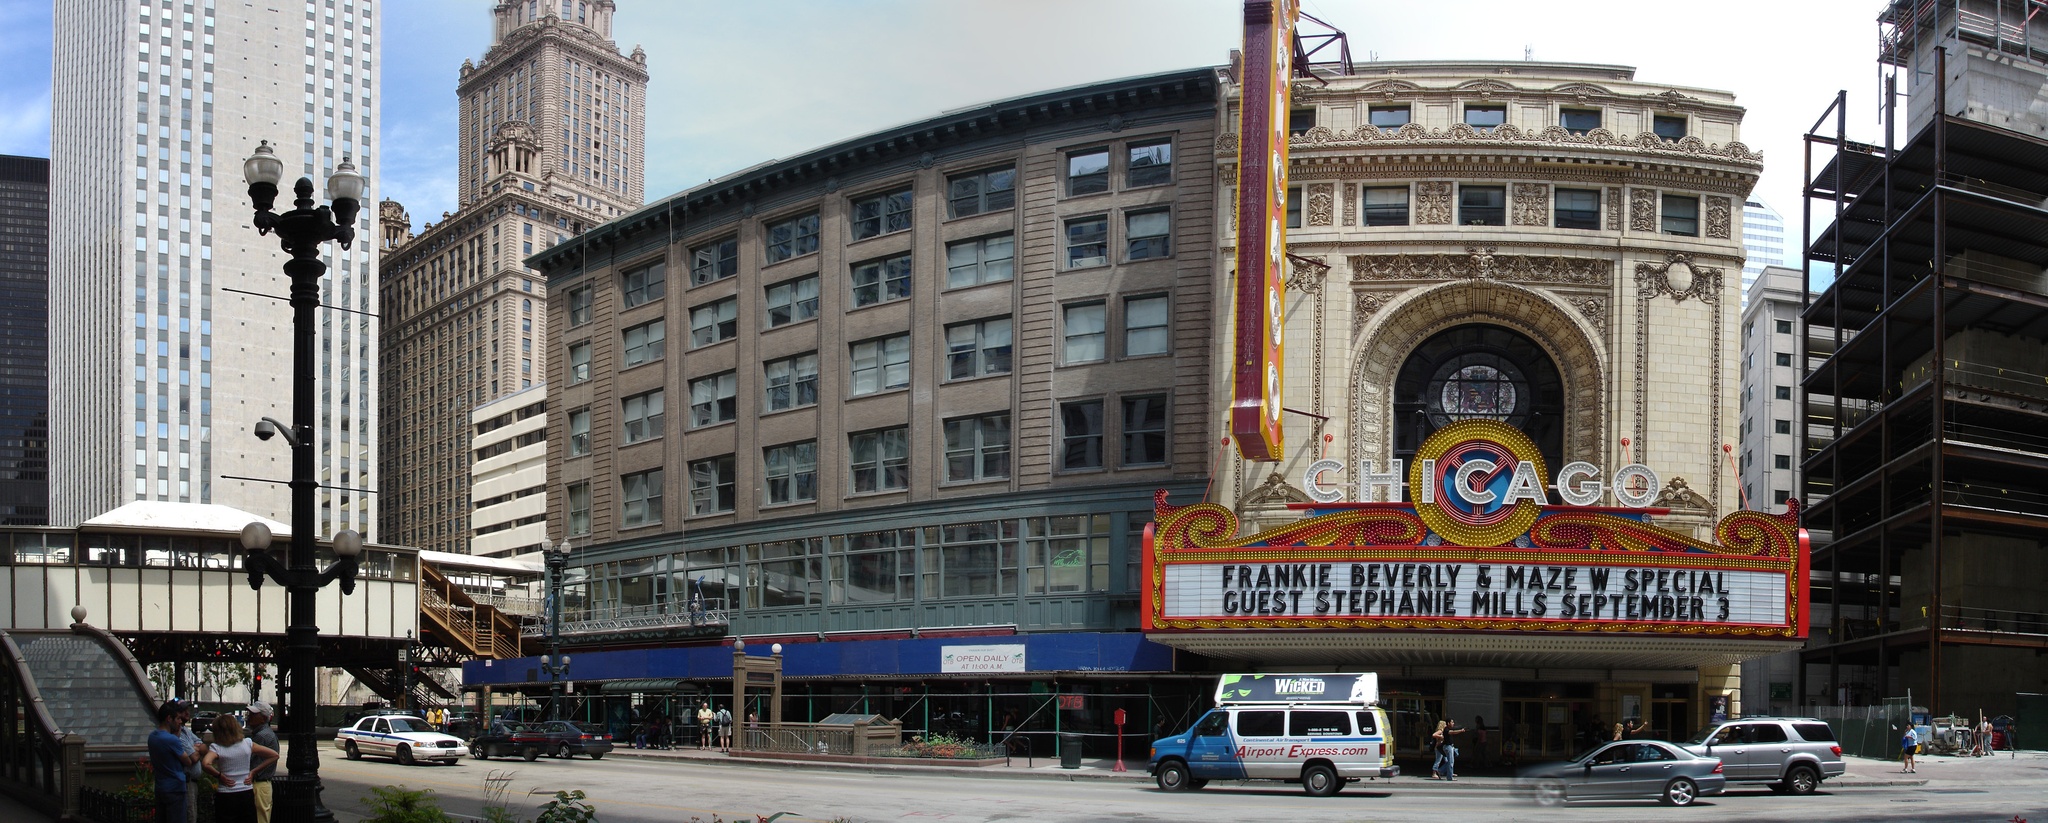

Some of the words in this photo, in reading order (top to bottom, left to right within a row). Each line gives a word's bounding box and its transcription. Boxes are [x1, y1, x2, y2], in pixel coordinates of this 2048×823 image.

[1303, 458, 1661, 508] CHICAGO
[1222, 563, 1332, 588] FRANKIE
[1350, 563, 1462, 588] BEVERLY
[1477, 564, 1492, 589] &
[1506, 565, 1578, 590] MAZE
[1590, 567, 1610, 591] W
[1624, 568, 1730, 595] SPECIAL
[1223, 590, 1303, 614] GUEST
[1315, 589, 1457, 614] STEPHANIE
[1471, 590, 1547, 616] MILLS
[1561, 593, 1705, 620] SEPTEMBER
[1717, 596, 1730, 620] 3
[1058, 695, 1084, 709] OTB
[1233, 745, 1285, 759] Airport
[1287, 744, 1369, 758] Express.com
